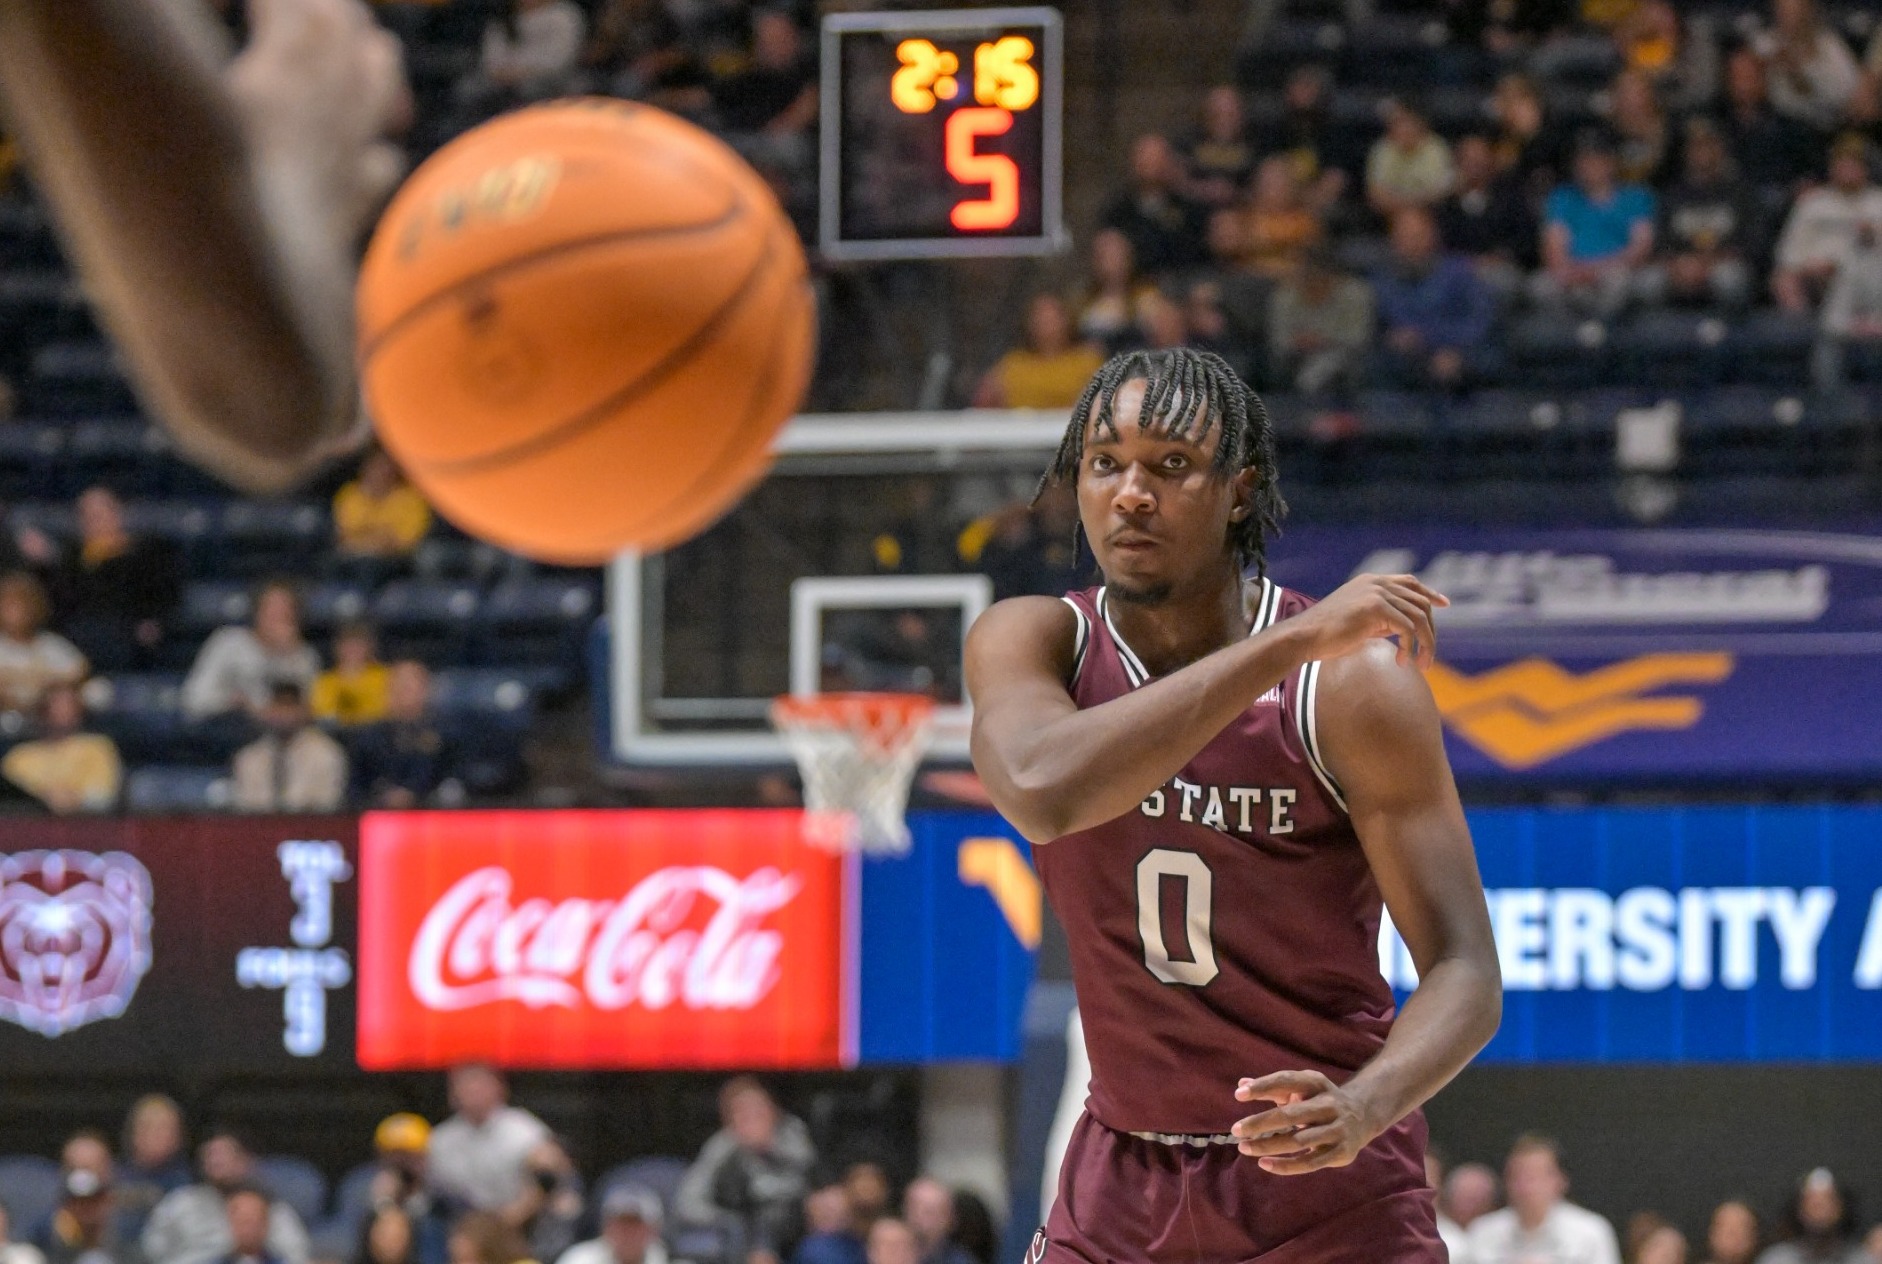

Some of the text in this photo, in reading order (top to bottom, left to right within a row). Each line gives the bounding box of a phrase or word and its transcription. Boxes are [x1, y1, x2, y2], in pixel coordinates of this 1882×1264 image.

[945, 107, 1019, 230] 5
[1136, 848, 1219, 986] 0
[1377, 887, 1836, 991] ERSITY
